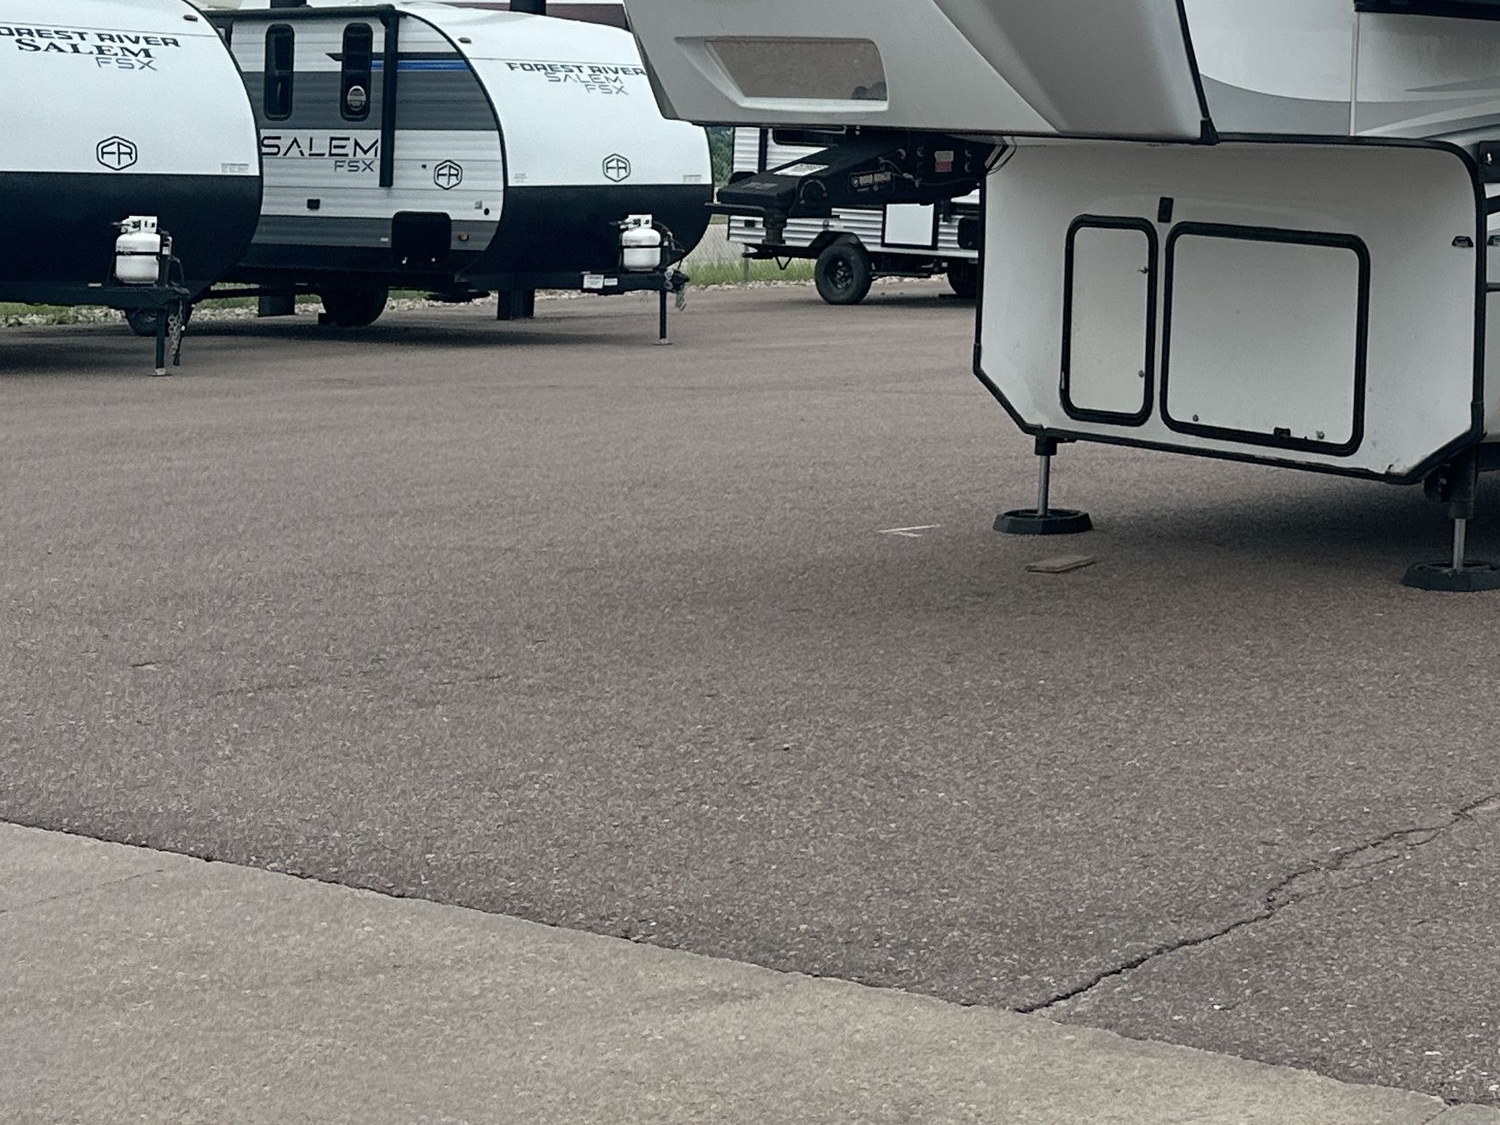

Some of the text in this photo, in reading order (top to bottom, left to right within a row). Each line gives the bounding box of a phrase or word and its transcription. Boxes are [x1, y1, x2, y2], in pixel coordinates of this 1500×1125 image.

[0, 26, 181, 47] OREST RIVER
[15, 38, 156, 59] SALEM
[95, 57, 157, 71] FSX
[505, 62, 646, 76] FOREST RIVER
[544, 72, 623, 84] SALEM
[585, 84, 629, 95] FSX
[261, 136, 379, 158] SALEM
[334, 160, 375, 173] FSX
